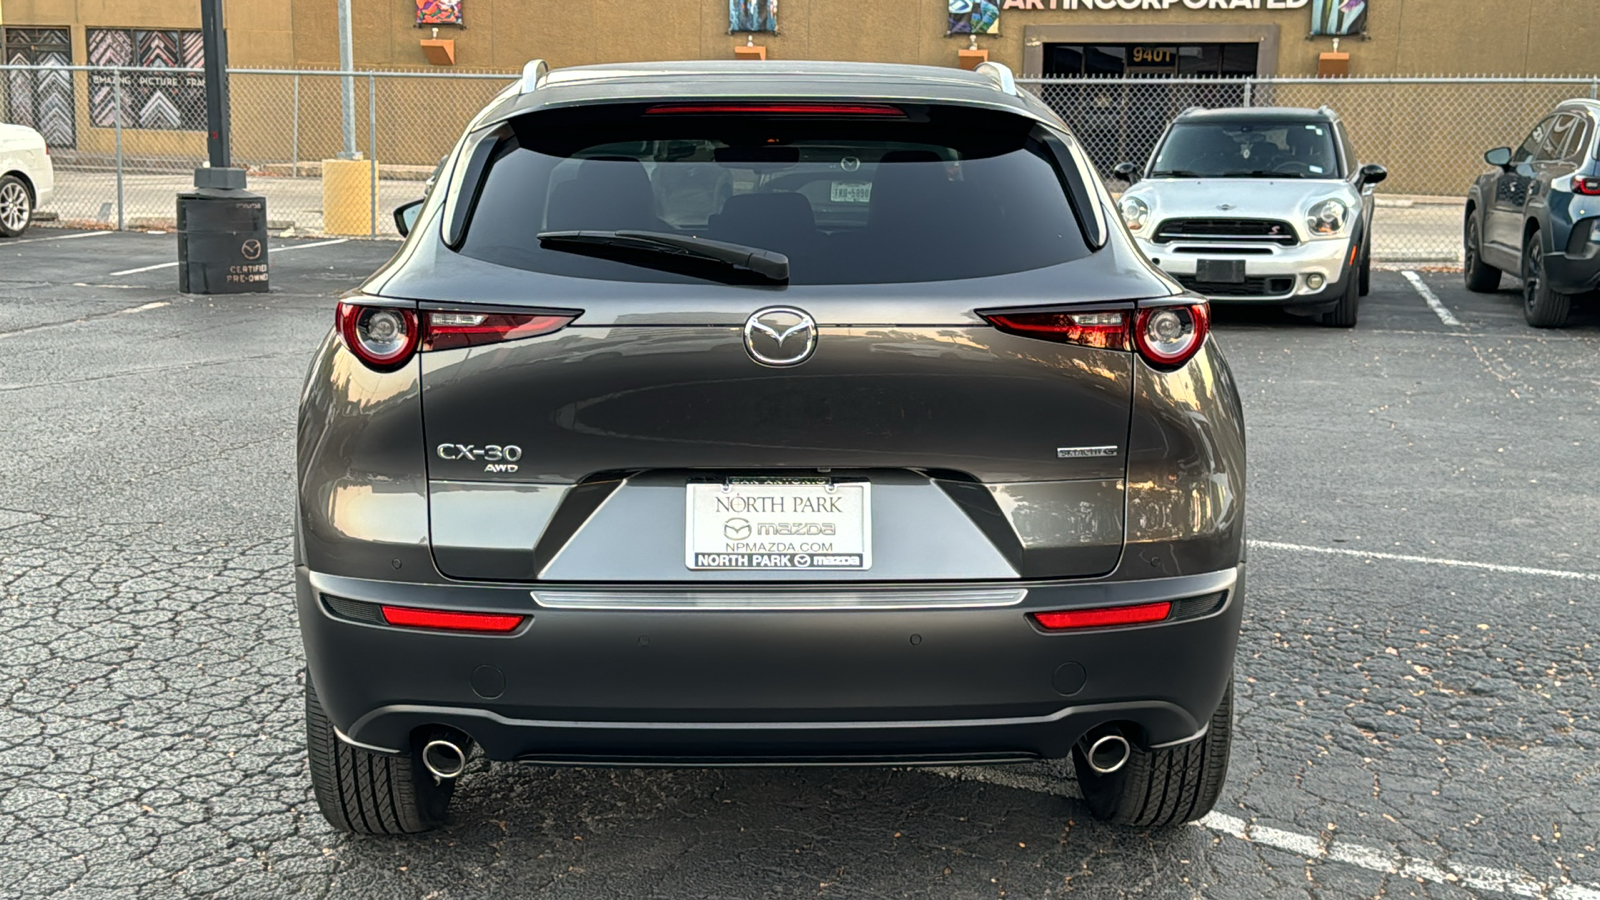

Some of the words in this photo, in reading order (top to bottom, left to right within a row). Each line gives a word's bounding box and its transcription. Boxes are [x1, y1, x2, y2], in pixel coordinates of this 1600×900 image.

[1133, 47, 1171, 62] 9401
[92, 75, 131, 84] MAZNG
[139, 77, 178, 86] PICTURE
[186, 78, 206, 87] FRA
[436, 443, 522, 461] CX-30
[484, 463, 519, 473] AWD
[715, 496, 785, 513] NORTH
[792, 496, 843, 513] PARK
[757, 522, 836, 535] mazda
[725, 542, 833, 552] NPMAZDA.COM
[698, 555, 748, 566] NORTH
[752, 555, 791, 566] PARK
[813, 555, 860, 566] mazda
